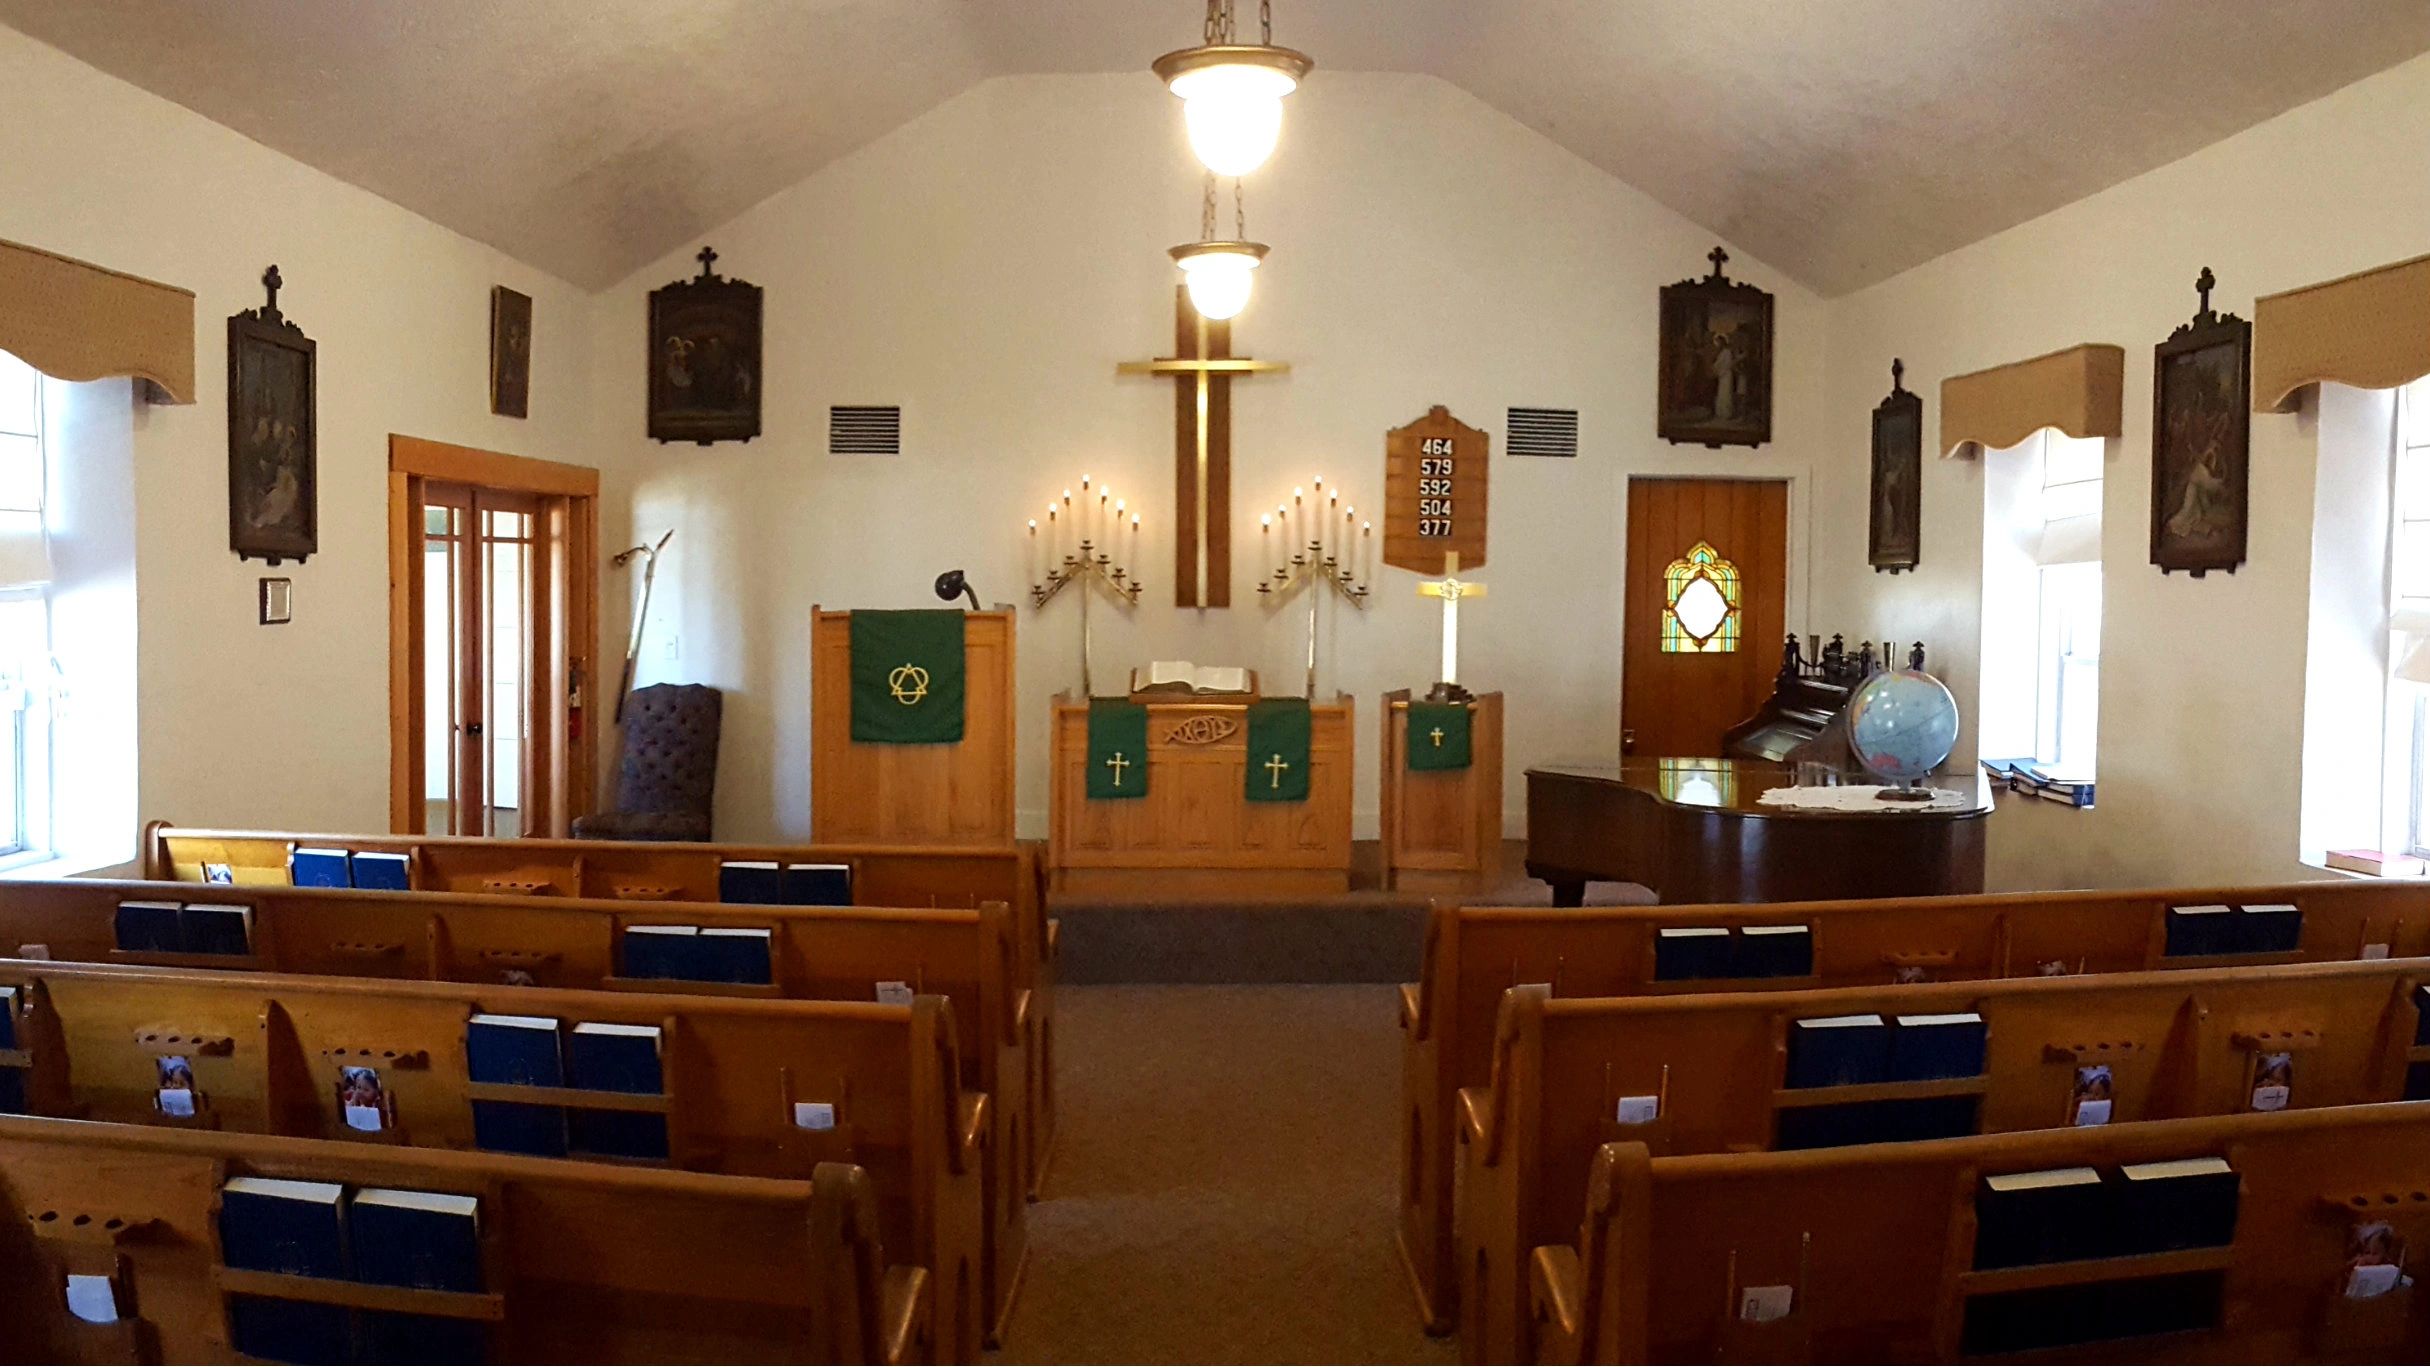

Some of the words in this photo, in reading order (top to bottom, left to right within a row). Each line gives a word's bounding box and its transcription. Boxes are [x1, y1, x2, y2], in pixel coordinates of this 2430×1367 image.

[1422, 438, 1453, 455] 464
[1421, 458, 1453, 475] 579
[1419, 478, 1451, 496] 592
[1420, 499, 1452, 516] 504
[1419, 519, 1452, 536] 377
